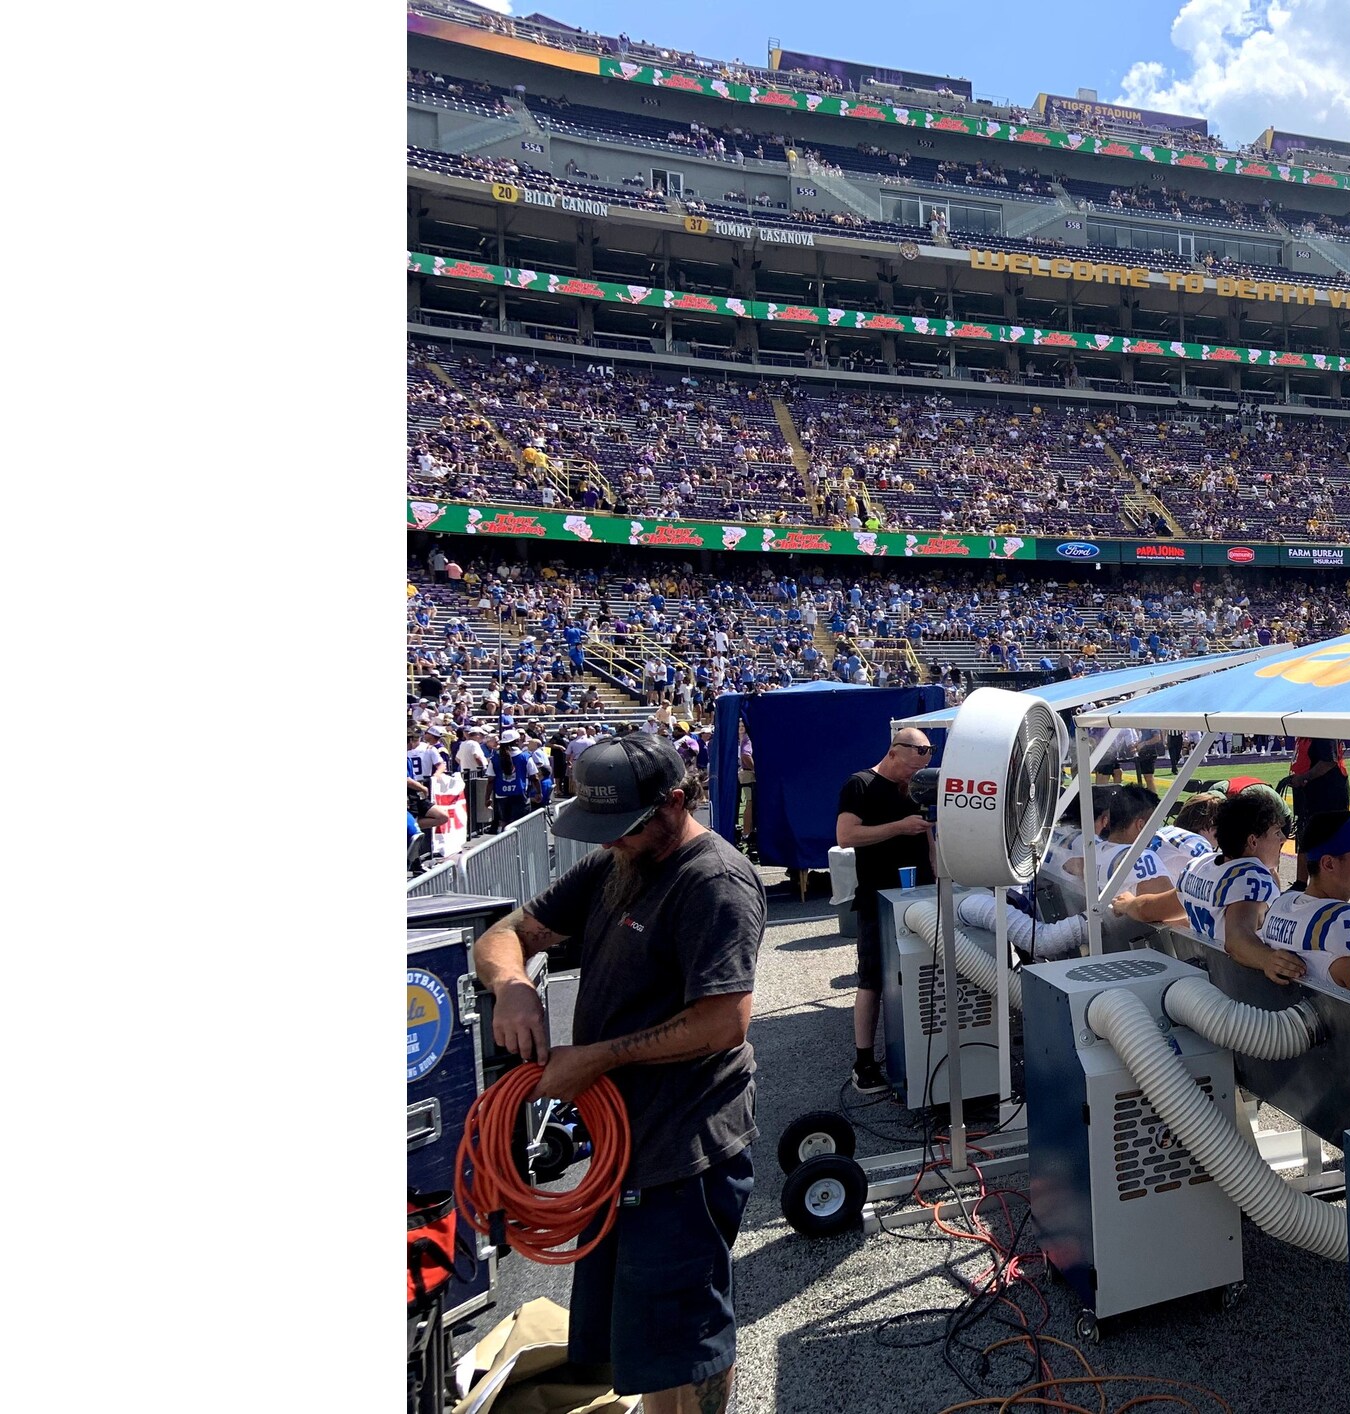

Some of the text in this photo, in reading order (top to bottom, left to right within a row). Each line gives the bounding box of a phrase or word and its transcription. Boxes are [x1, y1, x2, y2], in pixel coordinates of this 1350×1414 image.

[1061, 100, 1092, 113] TIGER
[1094, 105, 1142, 121] STADIUM
[525, 142, 541, 153] 554
[498, 186, 512, 200] 20
[799, 188, 815, 196] 556
[524, 190, 608, 217] BILLY CANNON
[690, 219, 703, 231] 37
[1067, 221, 1081, 230] 558
[713, 221, 815, 246] TOMMY CASANOVA
[970, 248, 1151, 289] WELCOME
[1163, 271, 1204, 294] TO
[1216, 277, 1315, 306] DEATH
[1064, 544, 1091, 556] Ford
[1136, 545, 1185, 556] PAPA JOHNS
[1312, 549, 1343, 558] BUREAU
[945, 778, 998, 796] BIG
[944, 793, 997, 811] FOGG
[1133, 854, 1157, 880] 50
[1244, 877, 1273, 902] 37
